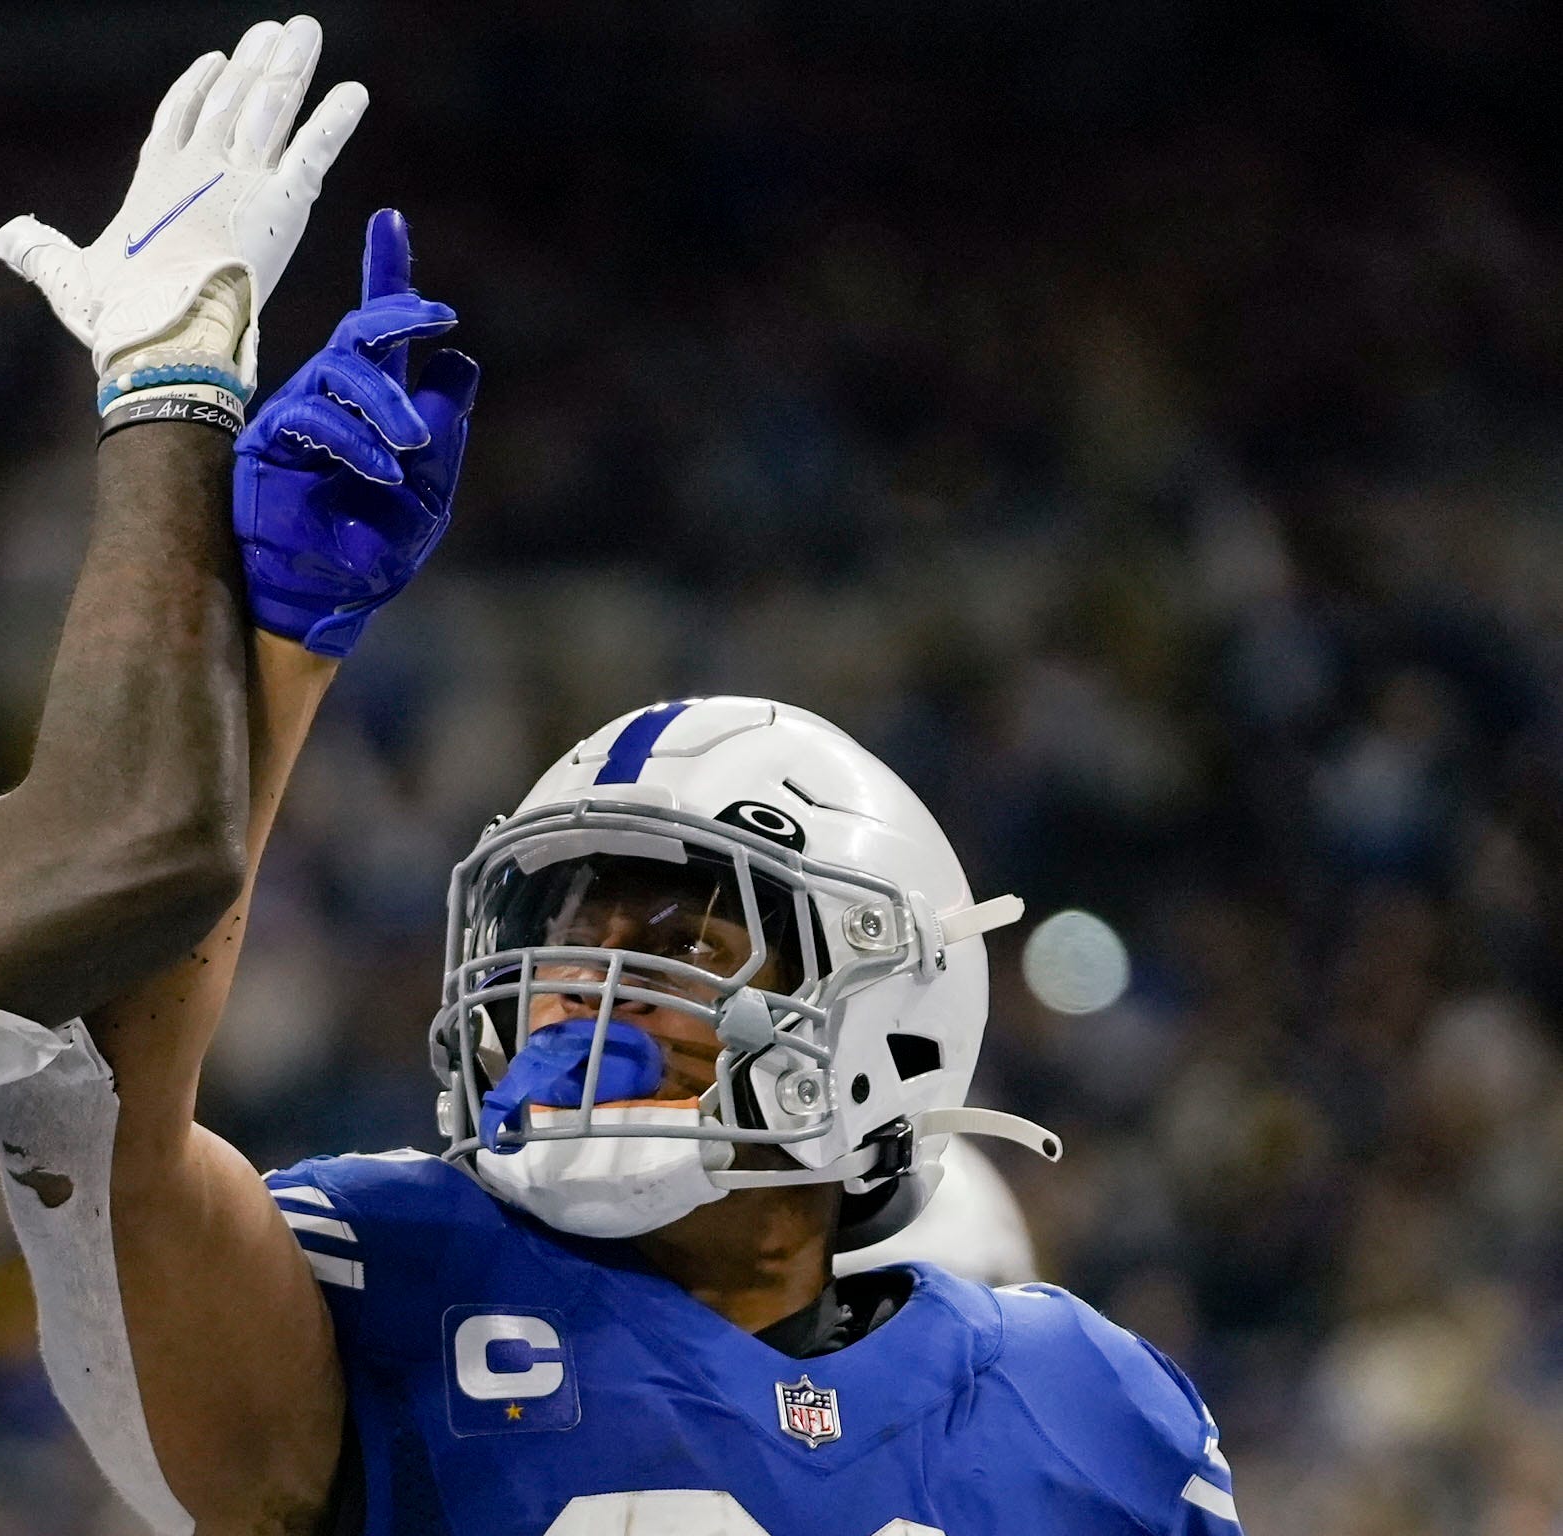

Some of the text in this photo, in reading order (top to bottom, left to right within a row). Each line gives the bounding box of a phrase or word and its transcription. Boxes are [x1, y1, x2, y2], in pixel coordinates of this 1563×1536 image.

[156, 399, 190, 418] AM
[454, 1314, 564, 1401] C
[789, 1406, 832, 1434] NFL
